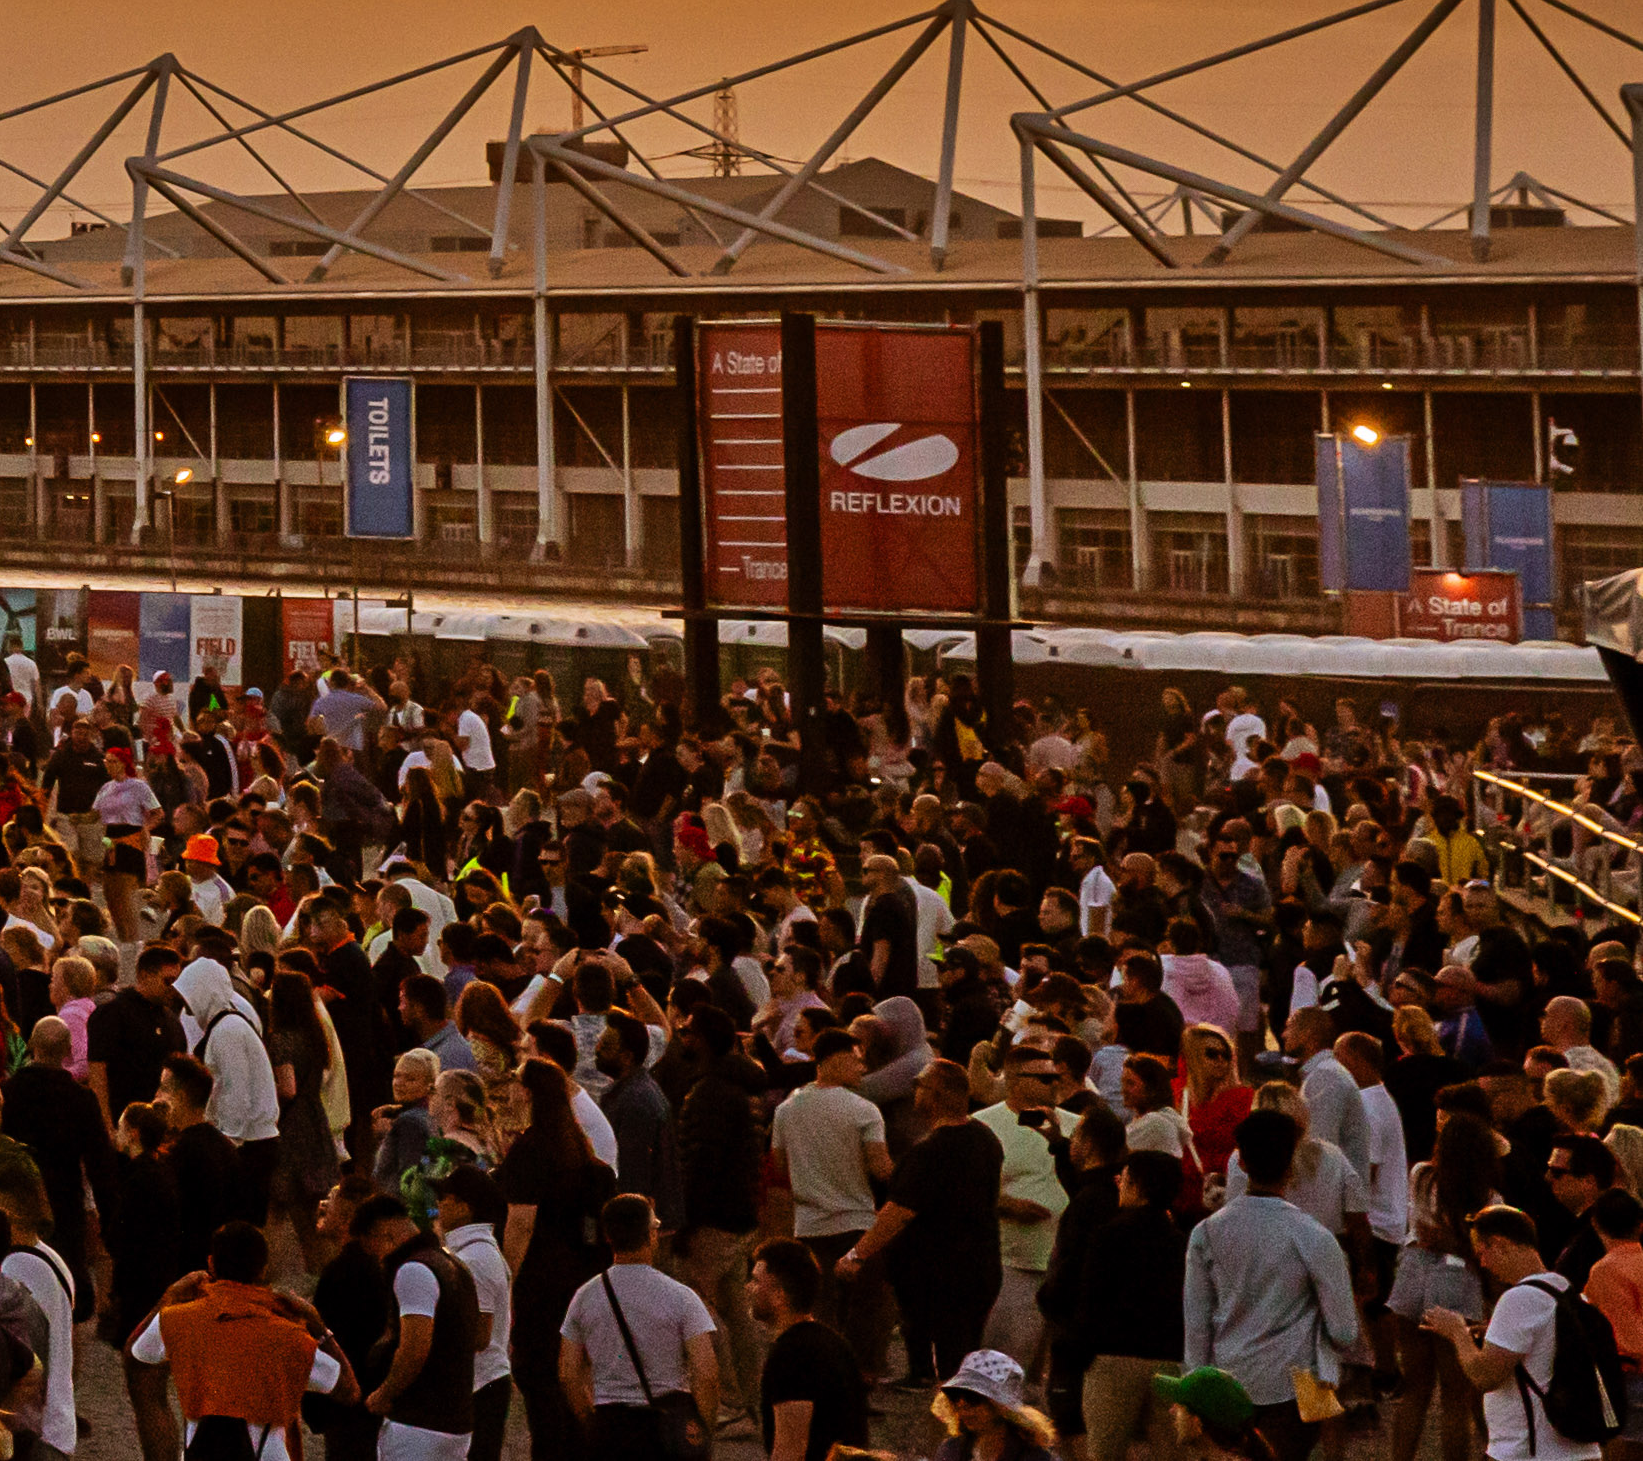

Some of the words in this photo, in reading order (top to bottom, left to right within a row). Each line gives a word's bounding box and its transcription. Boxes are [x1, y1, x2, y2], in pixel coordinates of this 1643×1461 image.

[712, 353, 724, 375] A
[726, 352, 765, 376] State
[769, 352, 782, 375] of
[367, 397, 391, 486] TOILETS
[830, 492, 961, 516] REFLEXION
[741, 555, 788, 580] Trance
[1407, 599, 1423, 613] A
[1428, 597, 1482, 615] State
[1487, 598, 1508, 616] of
[1444, 619, 1510, 638] Trance
[196, 638, 236, 656] FIELD
